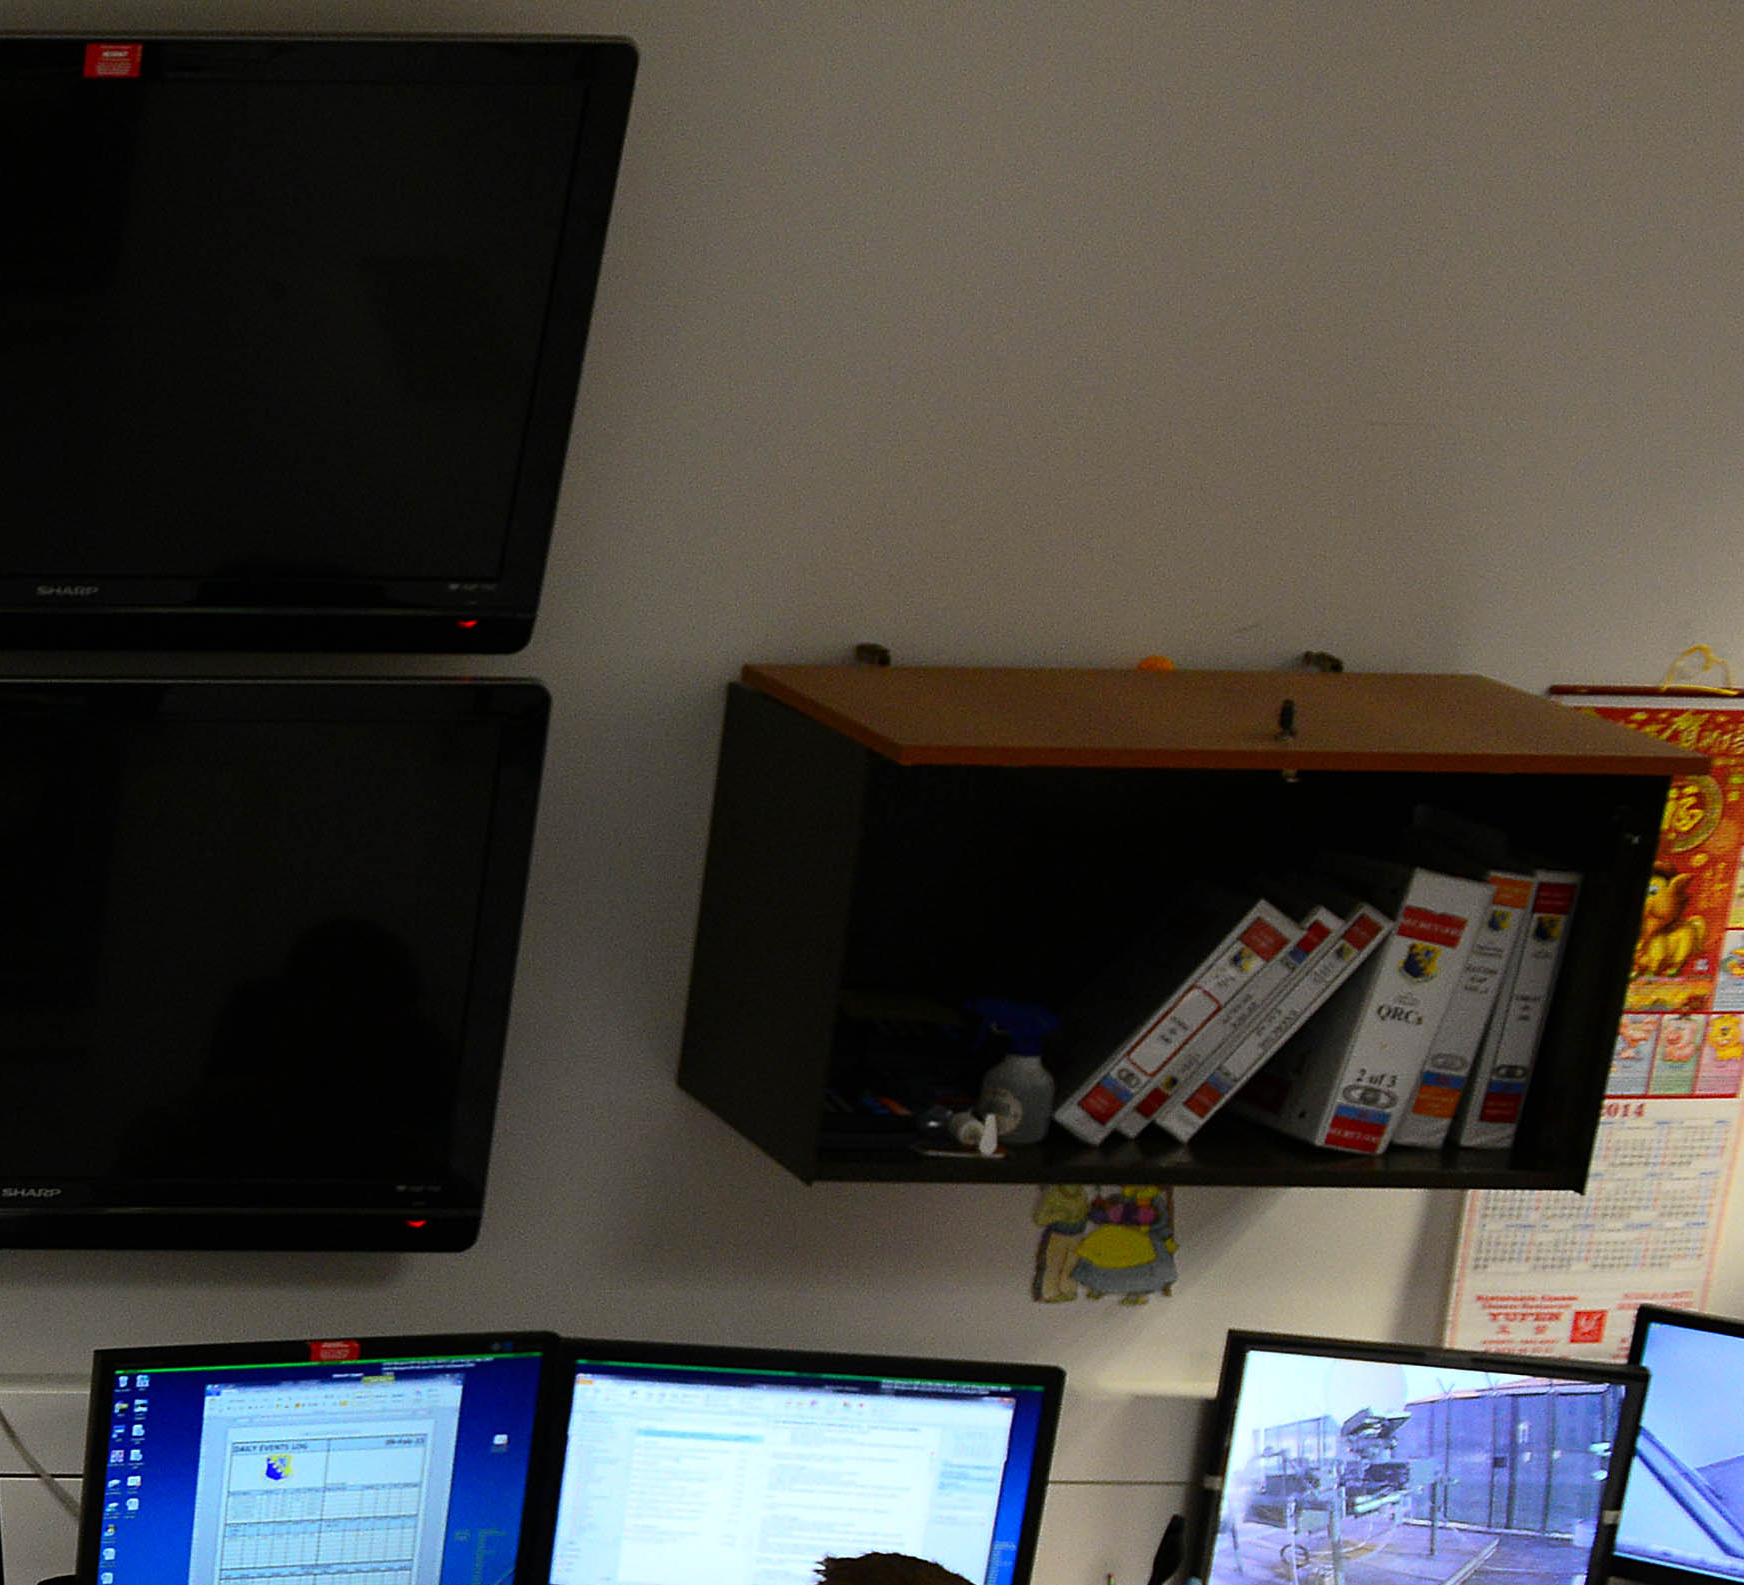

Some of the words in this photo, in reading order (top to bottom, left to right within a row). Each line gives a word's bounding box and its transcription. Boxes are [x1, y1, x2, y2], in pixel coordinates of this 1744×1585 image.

[35, 584, 99, 596] SHARP
[1376, 1004, 1424, 1026] QRCs
[1356, 1068, 1367, 1082] 2
[1370, 1070, 1387, 1086] of
[1389, 1073, 1398, 1087] 3
[0, 1187, 63, 1198] SHARP
[234, 1444, 257, 1453] DAILY
[260, 1442, 289, 1452] EVENTS
[292, 1441, 309, 1450] LOG
